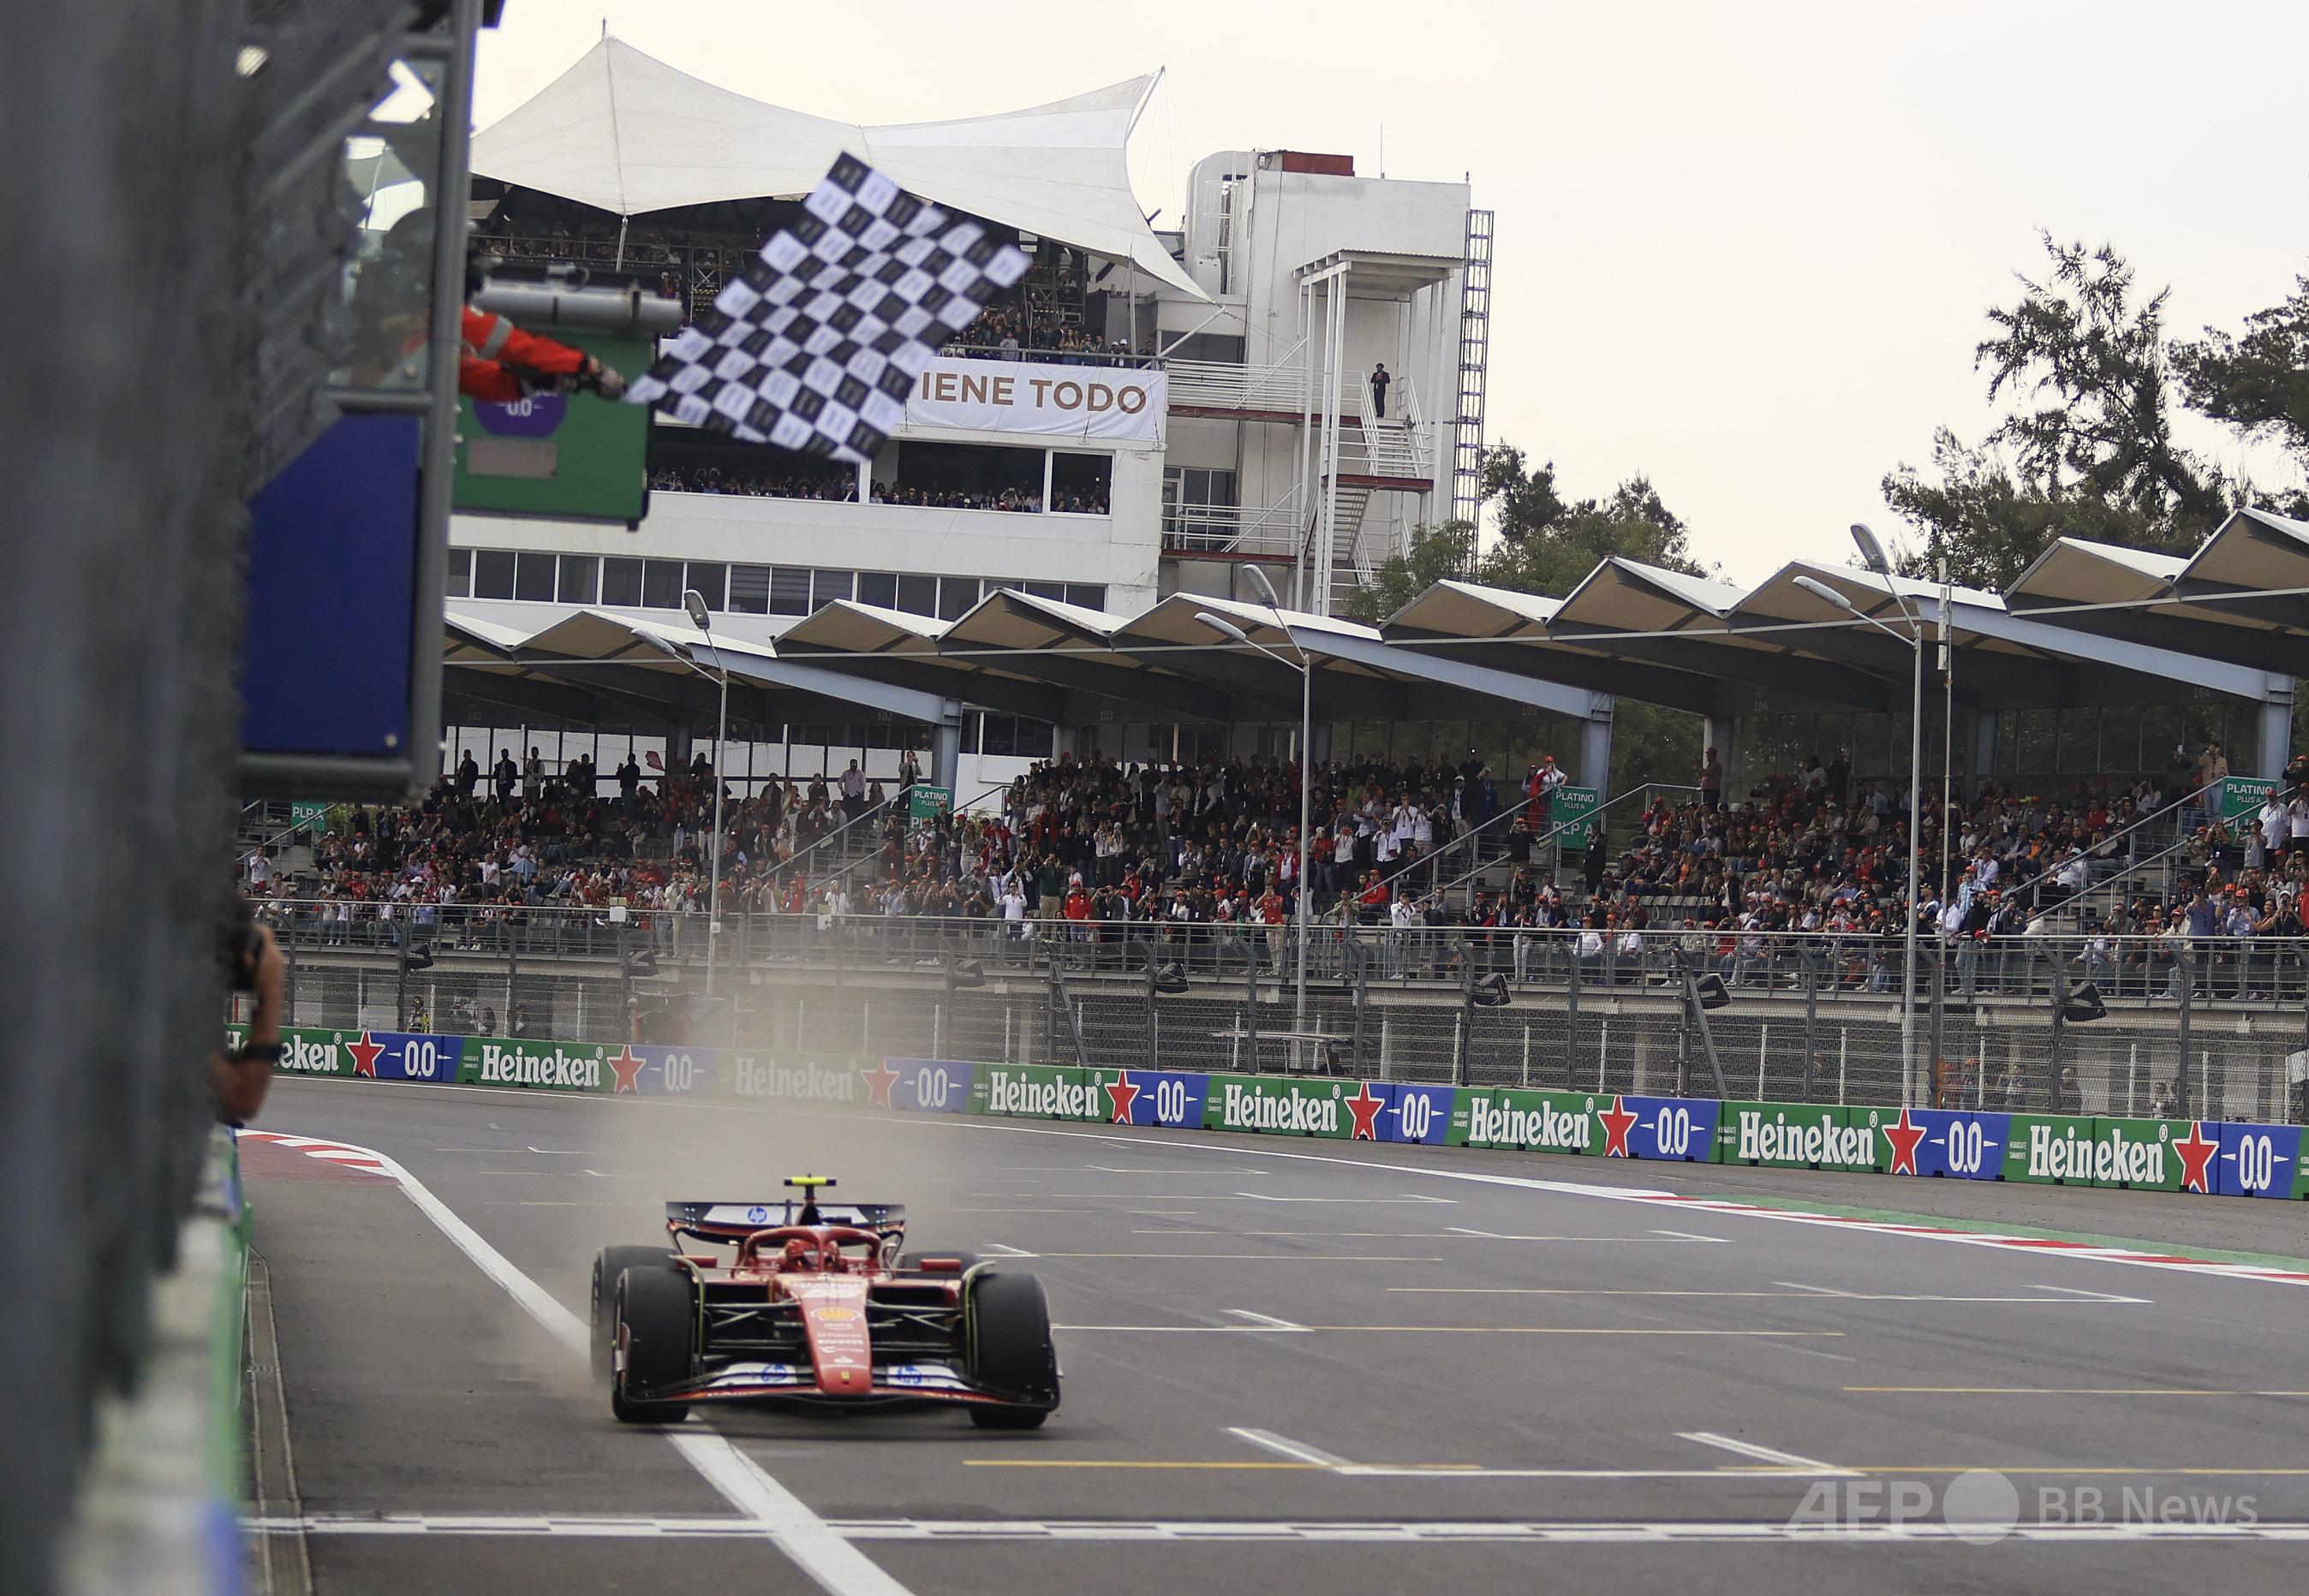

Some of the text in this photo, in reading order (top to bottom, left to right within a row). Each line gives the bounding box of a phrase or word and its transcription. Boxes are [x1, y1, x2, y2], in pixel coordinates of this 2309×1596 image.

[921, 372, 1147, 414] IENE TODO
[293, 807, 313, 819] PLP
[914, 790, 948, 801] PLATINO
[1555, 791, 1595, 802] PLATINO
[404, 1039, 435, 1077] 0.0
[480, 1045, 693, 1092] Heineken 0.0
[734, 1057, 947, 1107] Heineken 0.0
[989, 1071, 1184, 1123] Heineken 0.0
[1224, 1083, 1429, 1139] Heineken 0.0
[1469, 1096, 1689, 1155] Heineken 0.0
[1738, 1111, 1983, 1173] Heineken 0.0
[2028, 1125, 2272, 1191] Heineken 0.0
